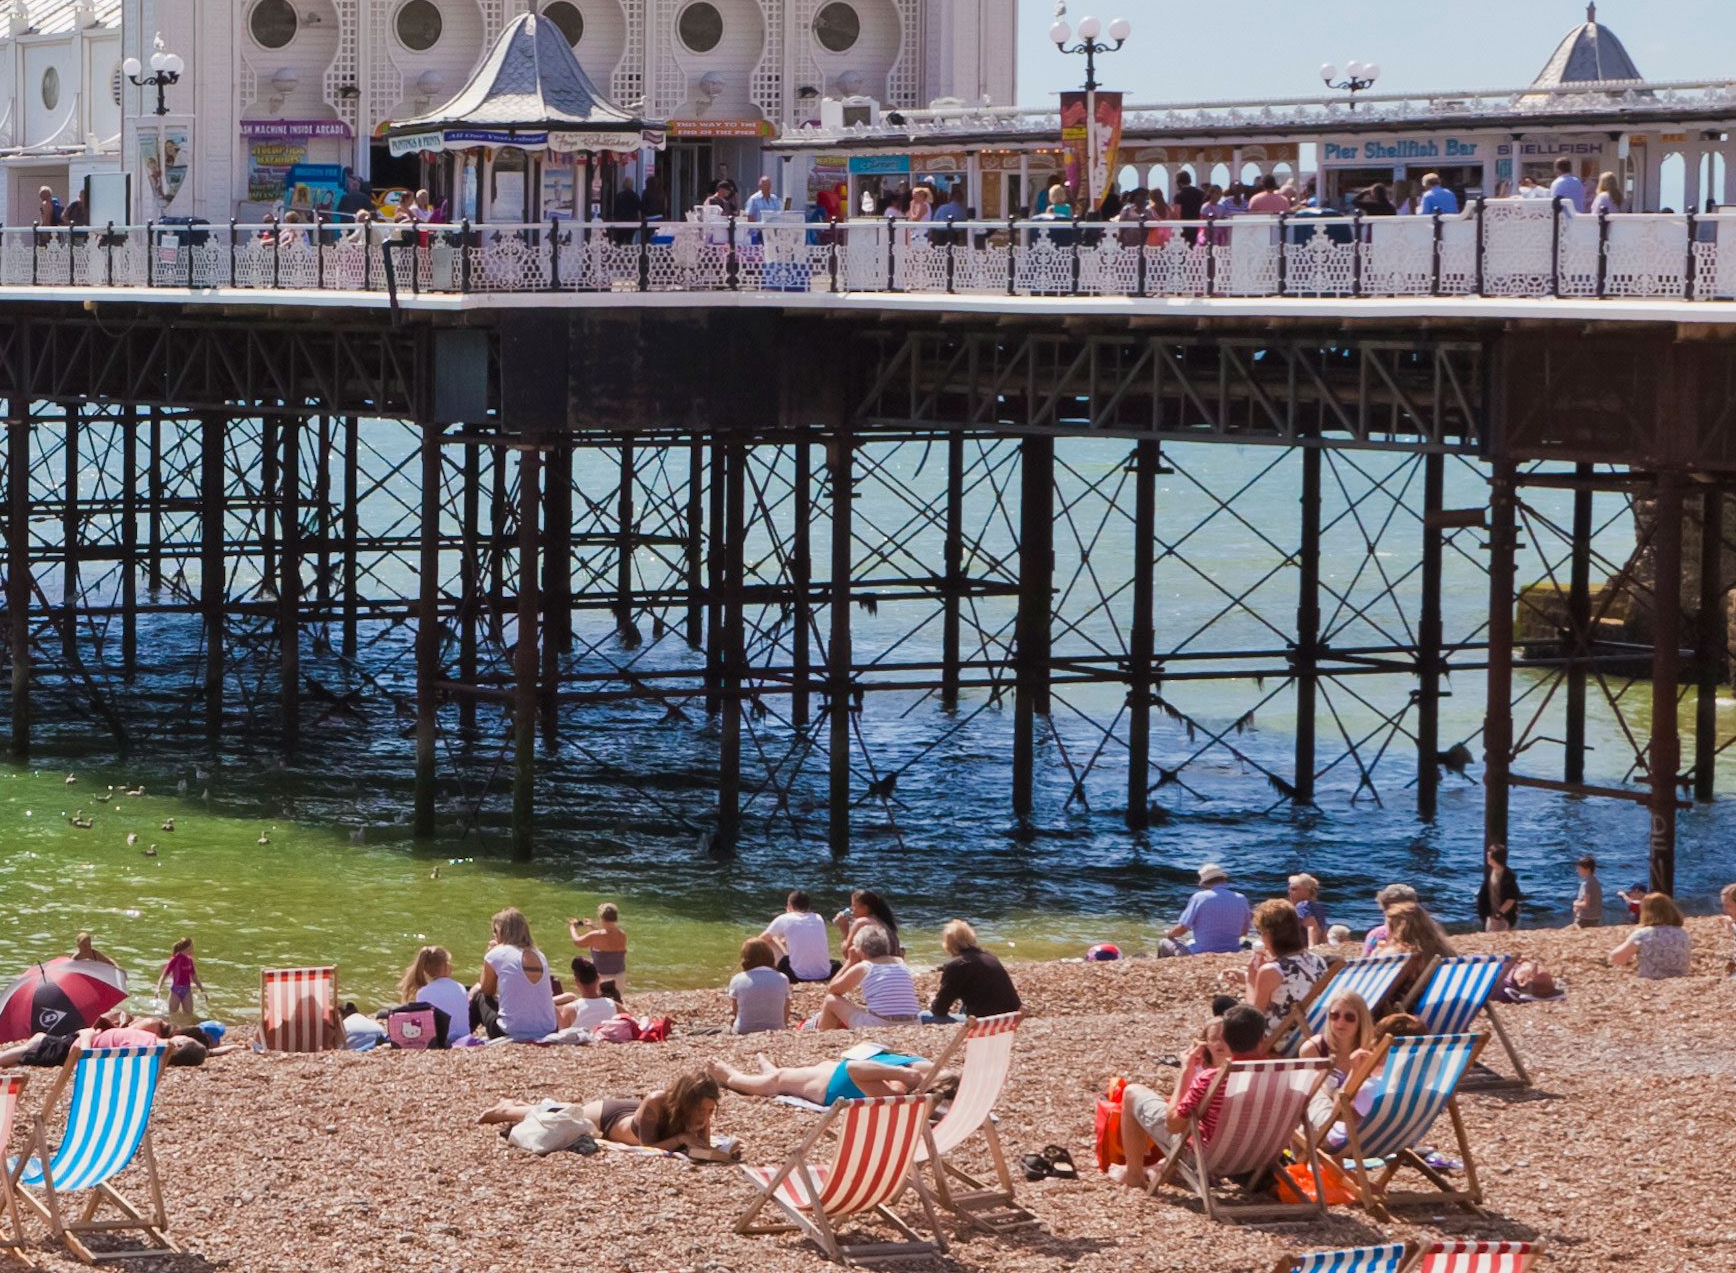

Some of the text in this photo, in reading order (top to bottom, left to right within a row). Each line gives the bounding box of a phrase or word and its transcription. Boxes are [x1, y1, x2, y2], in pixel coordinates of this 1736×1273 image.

[255, 125, 287, 135] MACHINE
[289, 125, 312, 135] INSIDE
[315, 125, 344, 135] ARCADE
[1324, 138, 1477, 159] Pier Shellfish Bar
